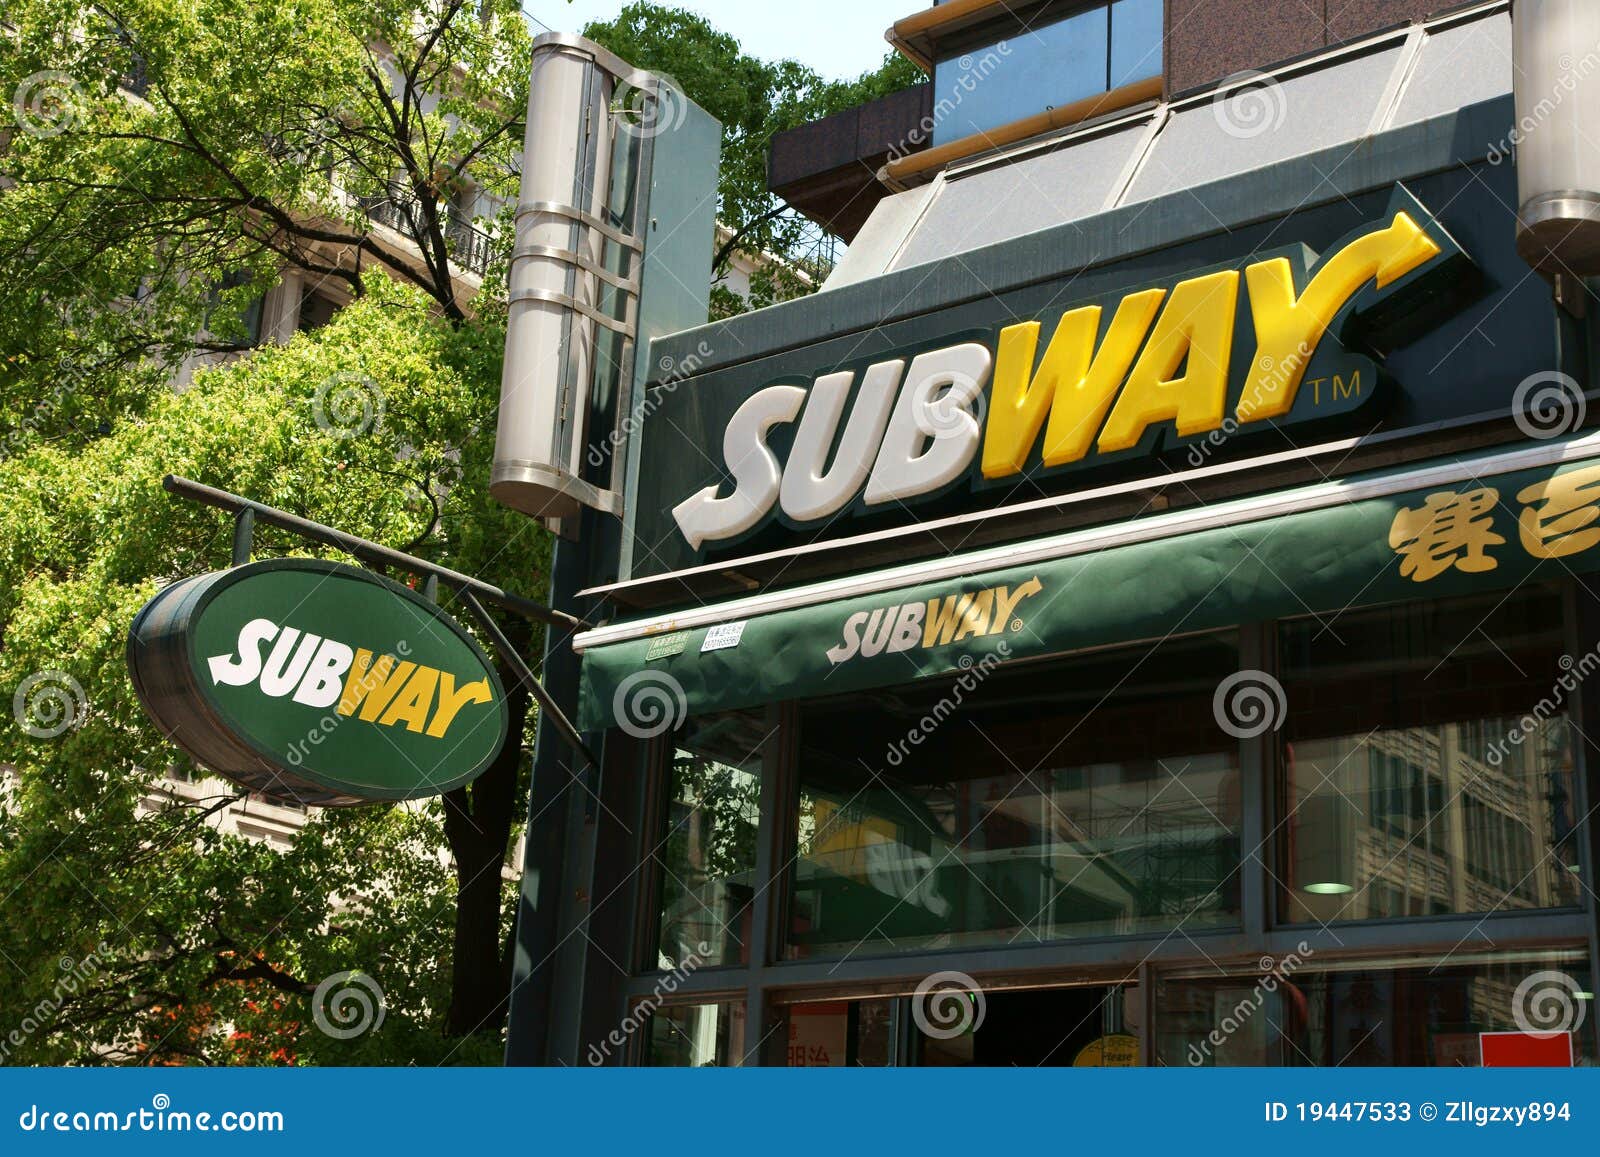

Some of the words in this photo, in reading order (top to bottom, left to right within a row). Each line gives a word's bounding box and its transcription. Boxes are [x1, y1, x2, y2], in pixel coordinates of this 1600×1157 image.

[672, 211, 1441, 551] SUBWAY
[1306, 369, 1361, 405] TM
[207, 618, 493, 738] SUBWAY
[826, 576, 1042, 665] SUBWAY
